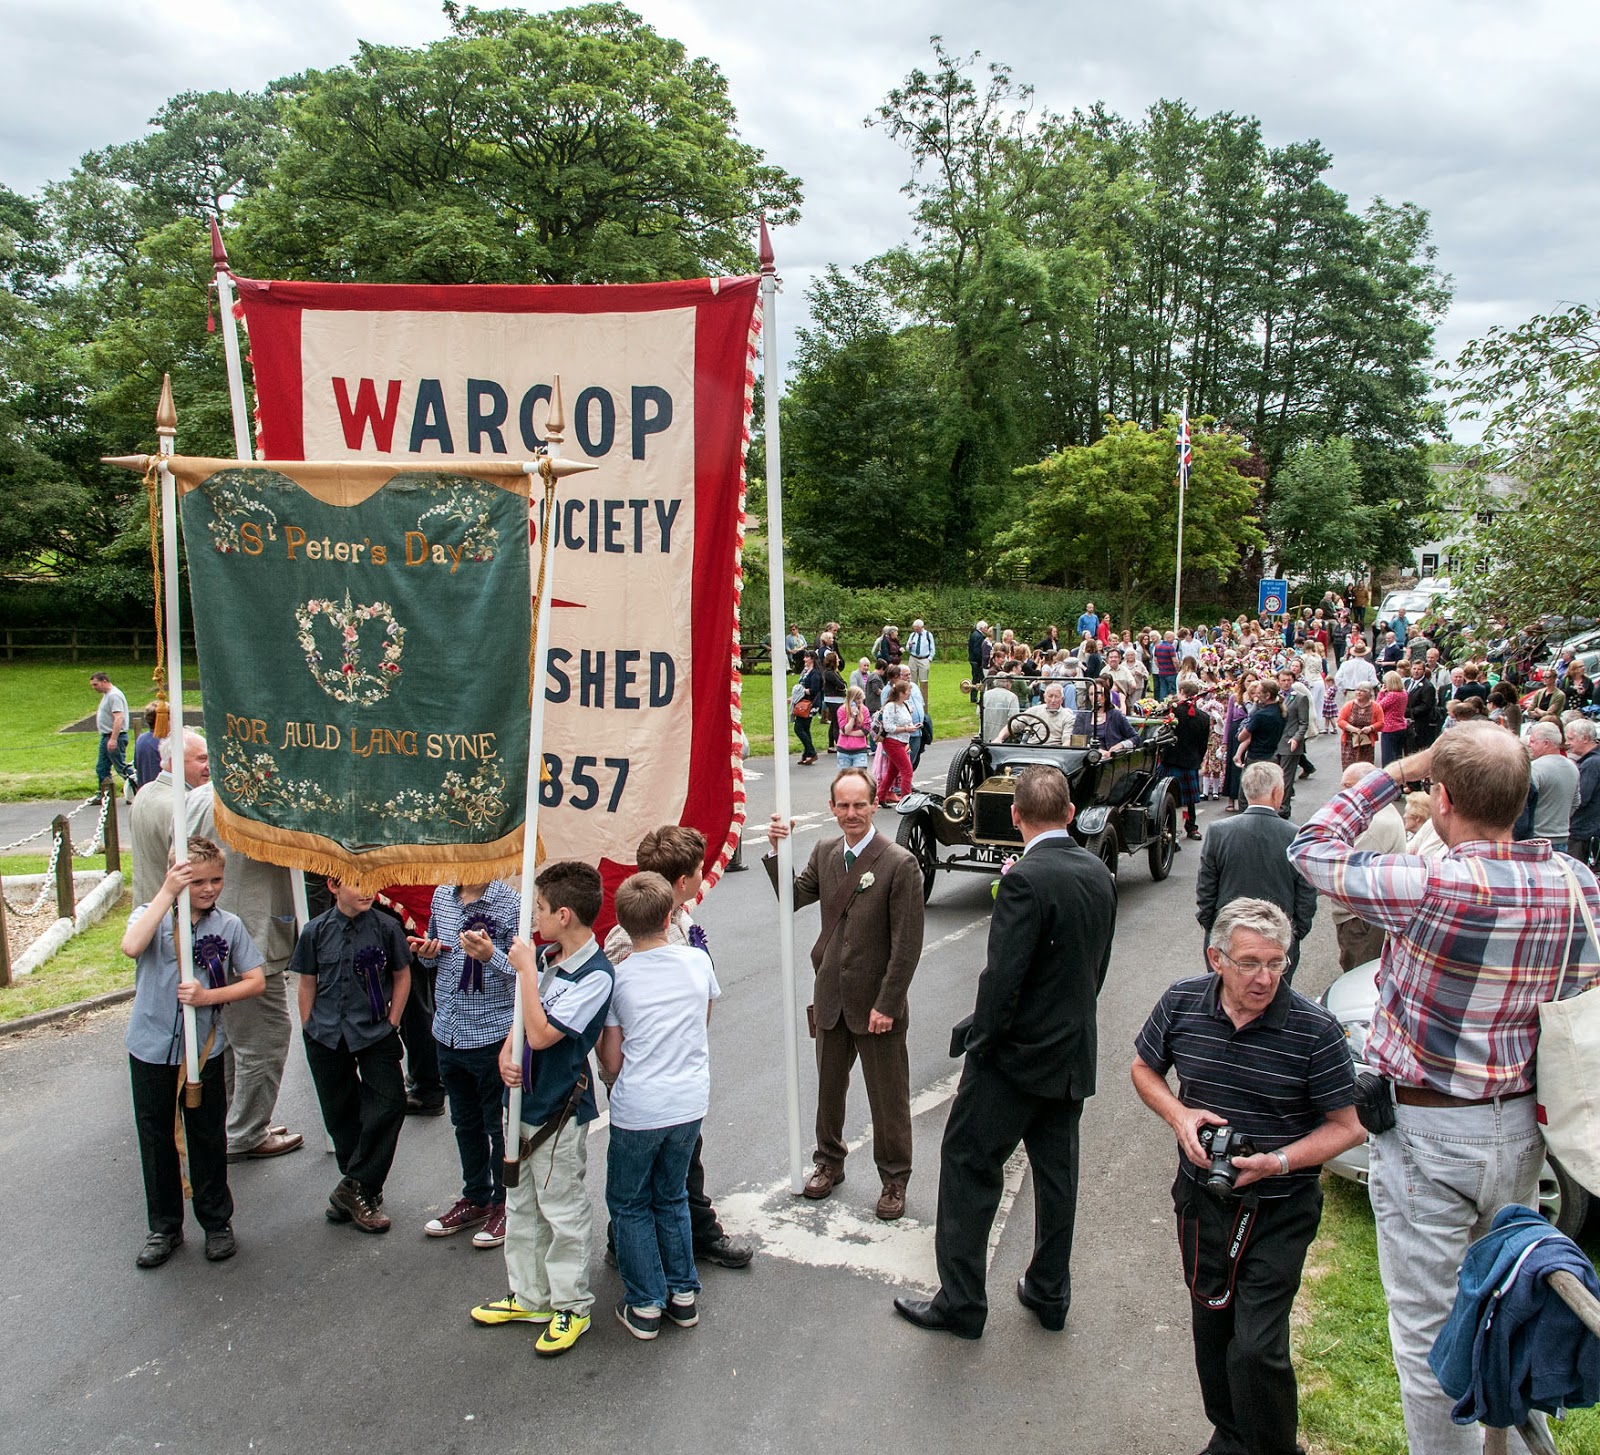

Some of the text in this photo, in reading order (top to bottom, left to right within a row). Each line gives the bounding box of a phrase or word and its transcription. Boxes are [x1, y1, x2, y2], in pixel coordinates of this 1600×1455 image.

[331, 376, 673, 460] WARCOP
[284, 525, 388, 567] Peter's
[405, 531, 465, 575] Day
[226, 713, 498, 762] FOR AULD LANG SYNE
[1229, 1212, 1250, 1259] EOS DIGITAL
